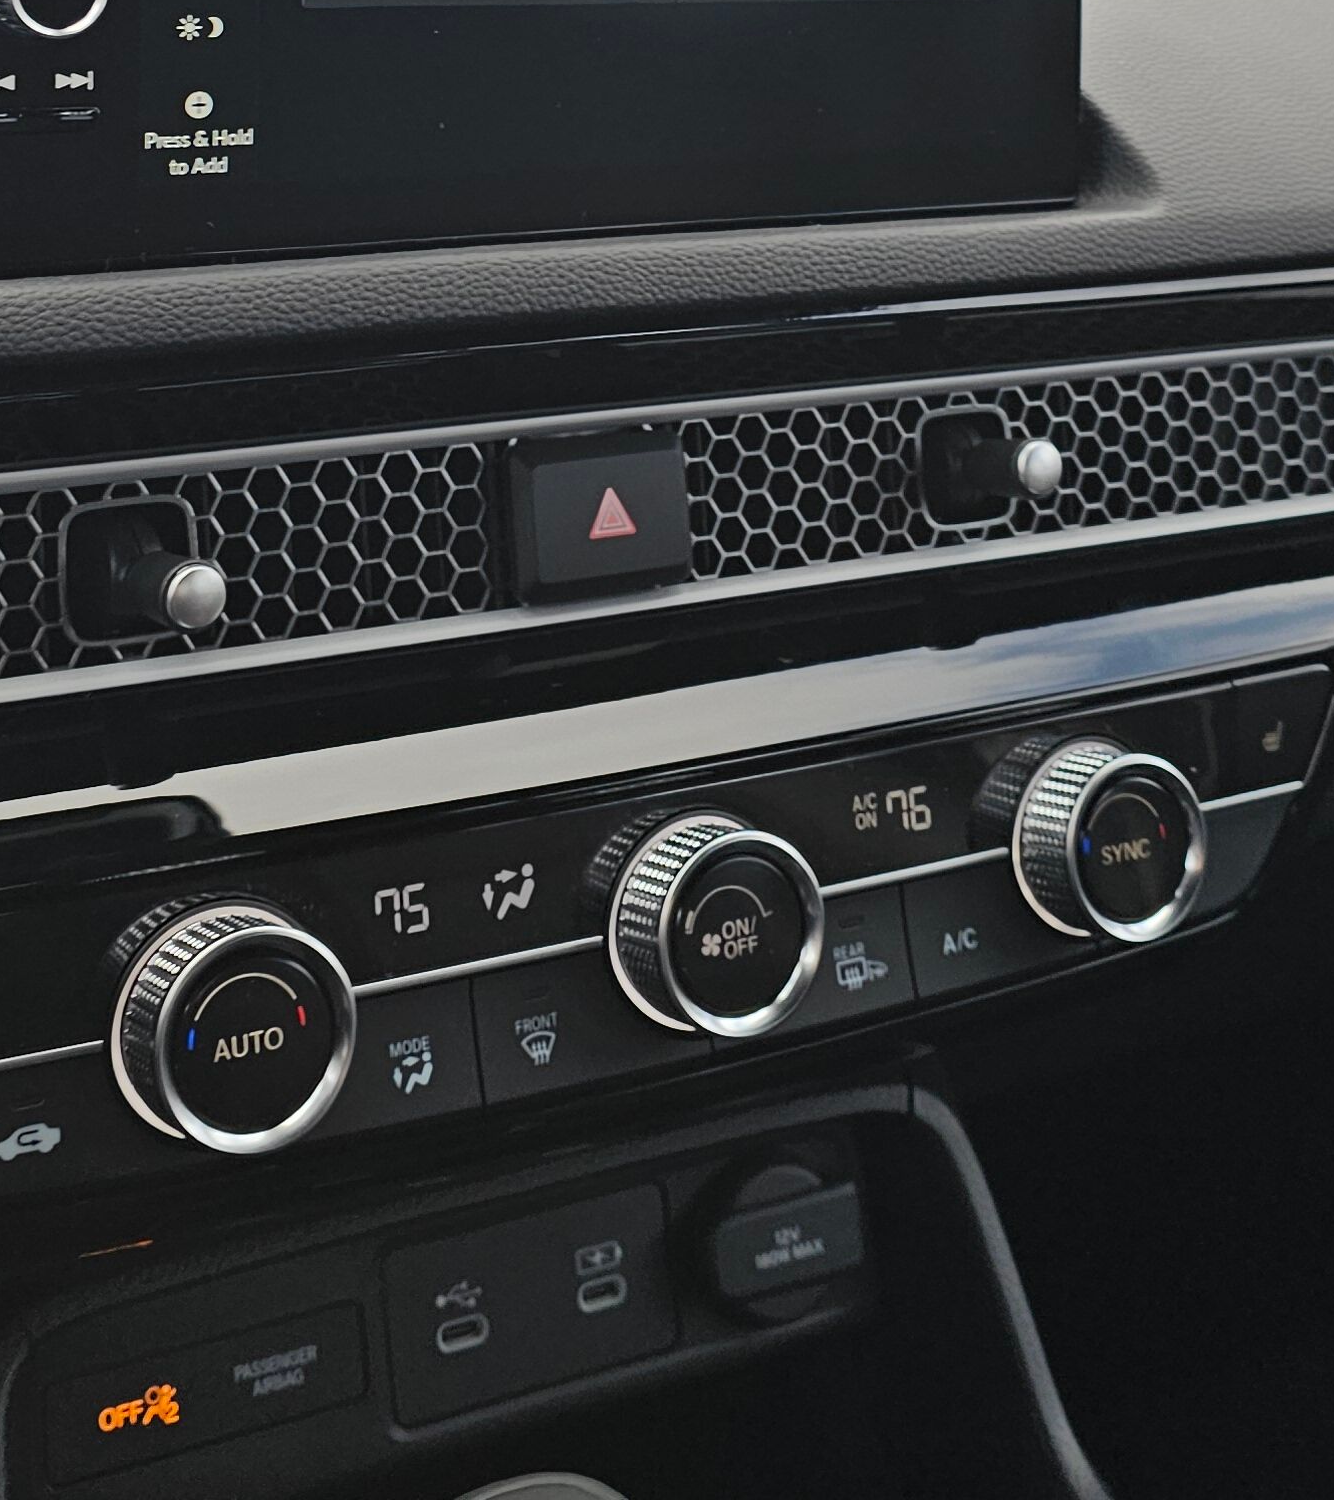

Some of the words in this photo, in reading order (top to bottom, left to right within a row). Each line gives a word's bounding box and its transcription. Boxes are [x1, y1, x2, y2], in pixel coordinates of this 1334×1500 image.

[144, 132, 192, 149] Press
[193, 130, 209, 147] &
[212, 128, 254, 146] Hold
[168, 159, 189, 175] to
[190, 156, 228, 174] Add
[852, 792, 878, 813] A/C
[885, 785, 932, 831] 76
[855, 811, 878, 831] ON
[1101, 839, 1152, 865] SYNC
[374, 883, 430, 934] 75
[721, 915, 757, 937] ON/
[723, 934, 758, 960] OFF
[833, 942, 865, 961] REAR
[943, 927, 978, 956] A/C
[514, 1012, 557, 1035] FRONT
[213, 1026, 285, 1064] AUTO
[389, 1035, 430, 1058] MODE
[233, 1344, 317, 1382] PASSENGER
[98, 1399, 144, 1433] OFF
